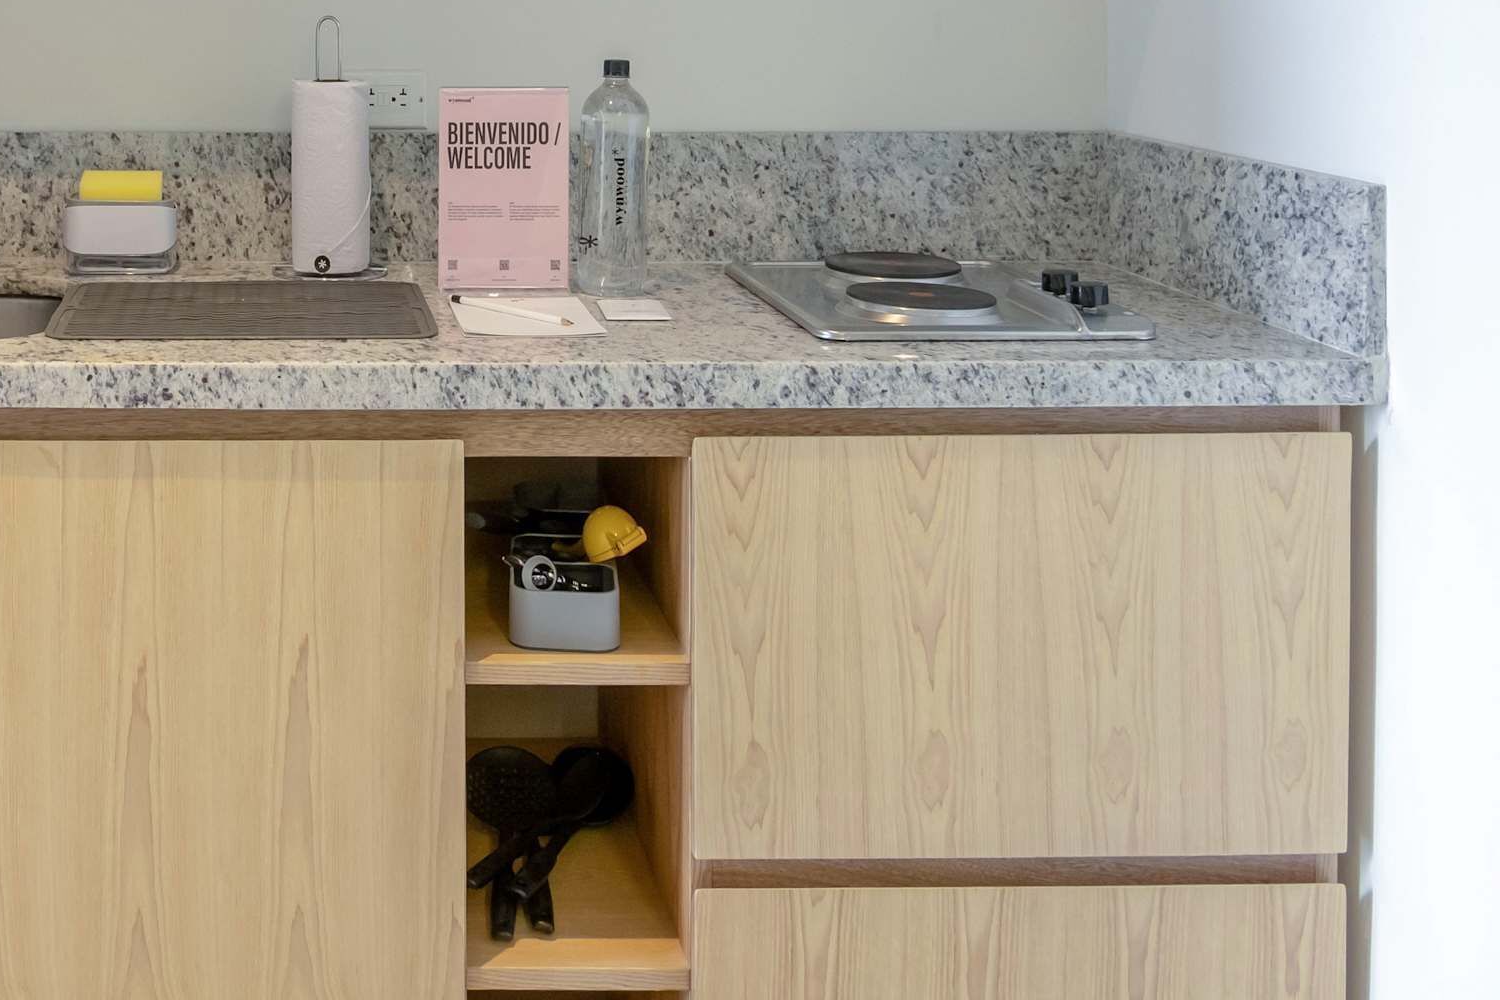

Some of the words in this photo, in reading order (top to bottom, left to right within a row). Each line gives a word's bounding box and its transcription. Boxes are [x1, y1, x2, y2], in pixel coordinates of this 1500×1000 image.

[448, 122, 549, 145] BIENVENIDO
[447, 146, 531, 169] WELCOME
[614, 158, 627, 226] wynwood
